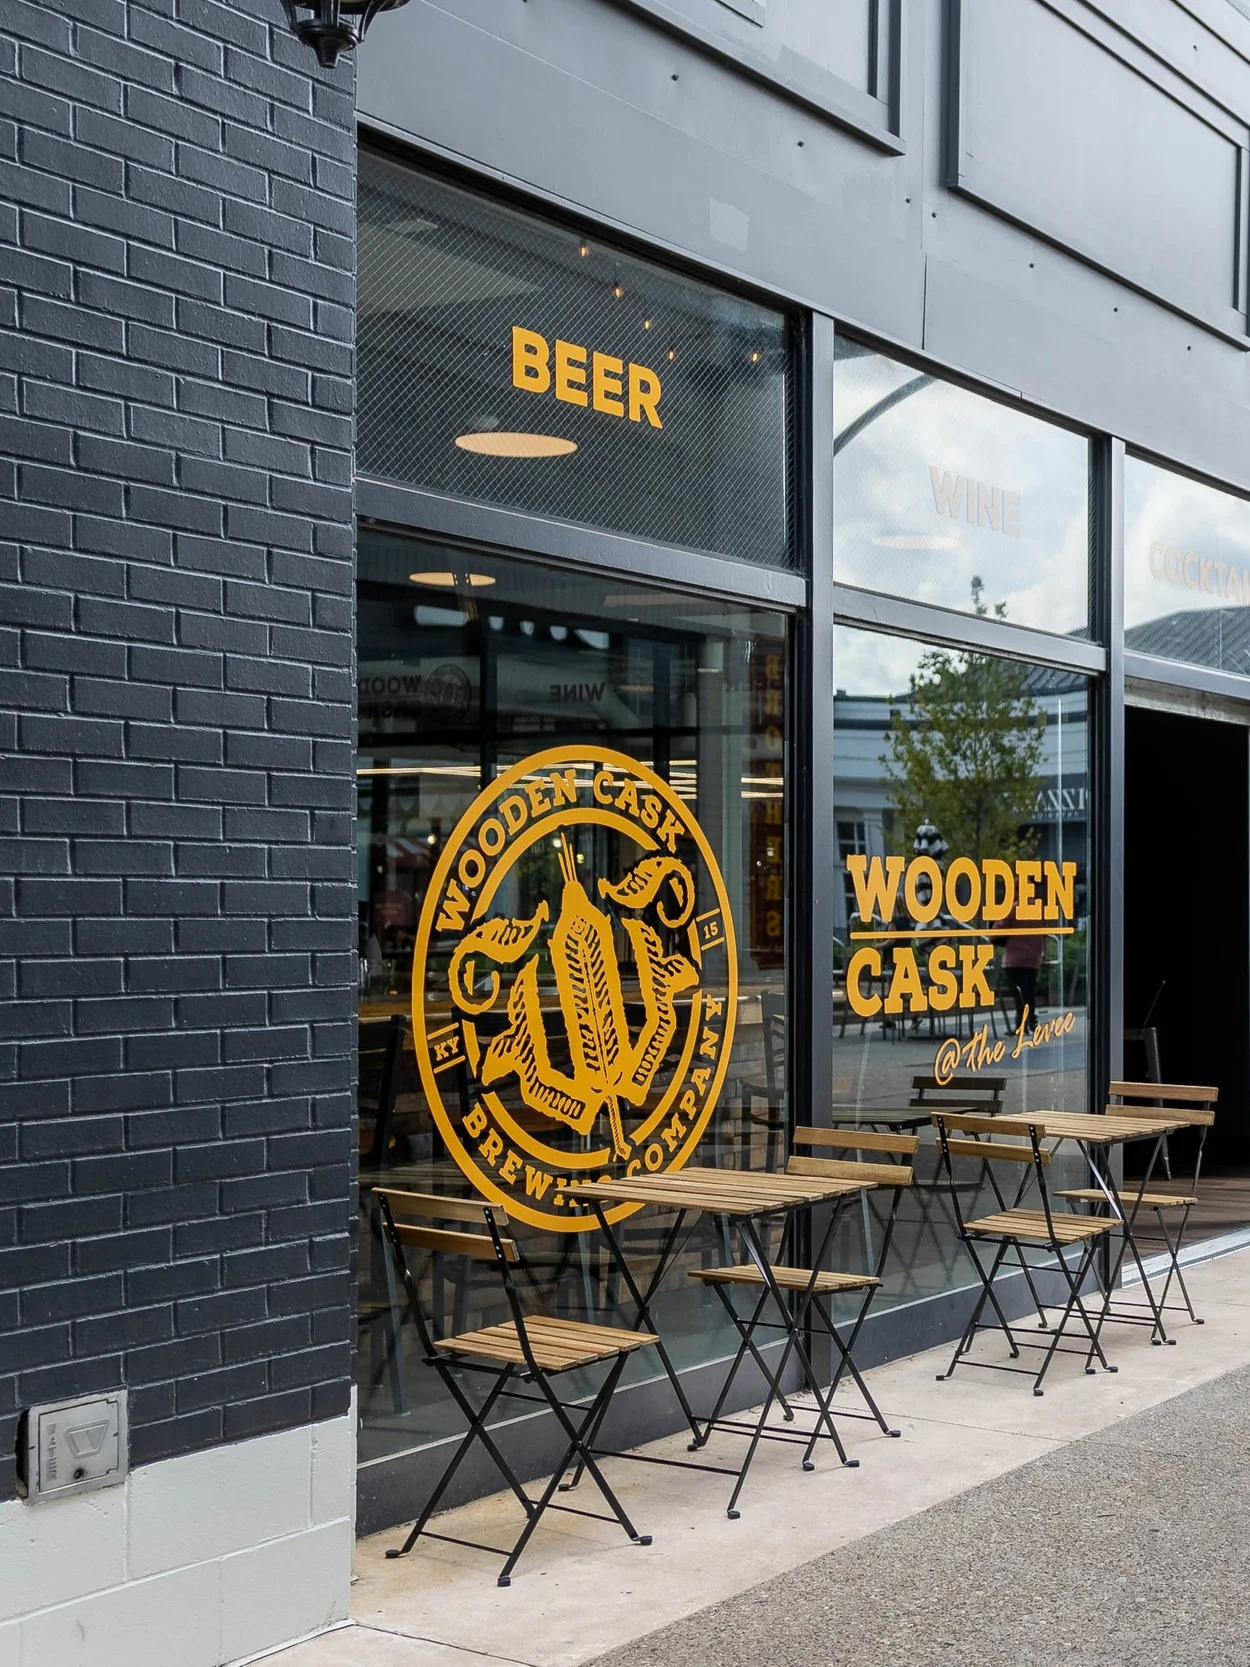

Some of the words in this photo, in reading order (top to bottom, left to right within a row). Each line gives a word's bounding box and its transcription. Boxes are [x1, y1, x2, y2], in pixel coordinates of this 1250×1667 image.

[511, 325, 664, 430] BEER
[928, 464, 1022, 538] WINE
[435, 768, 579, 935] WOODEN
[592, 770, 686, 853] CASK
[846, 854, 1077, 923] WOODEN
[702, 920, 721, 941] 15
[846, 944, 996, 1018] CASK
[433, 1033, 461, 1062] KY
[934, 1038, 962, 1086] @
[961, 1023, 1006, 1072] the
[1011, 1003, 1077, 1059] Levee
[626, 994, 725, 1179] COMPANY
[46, 1422, 58, 1481] WATER
